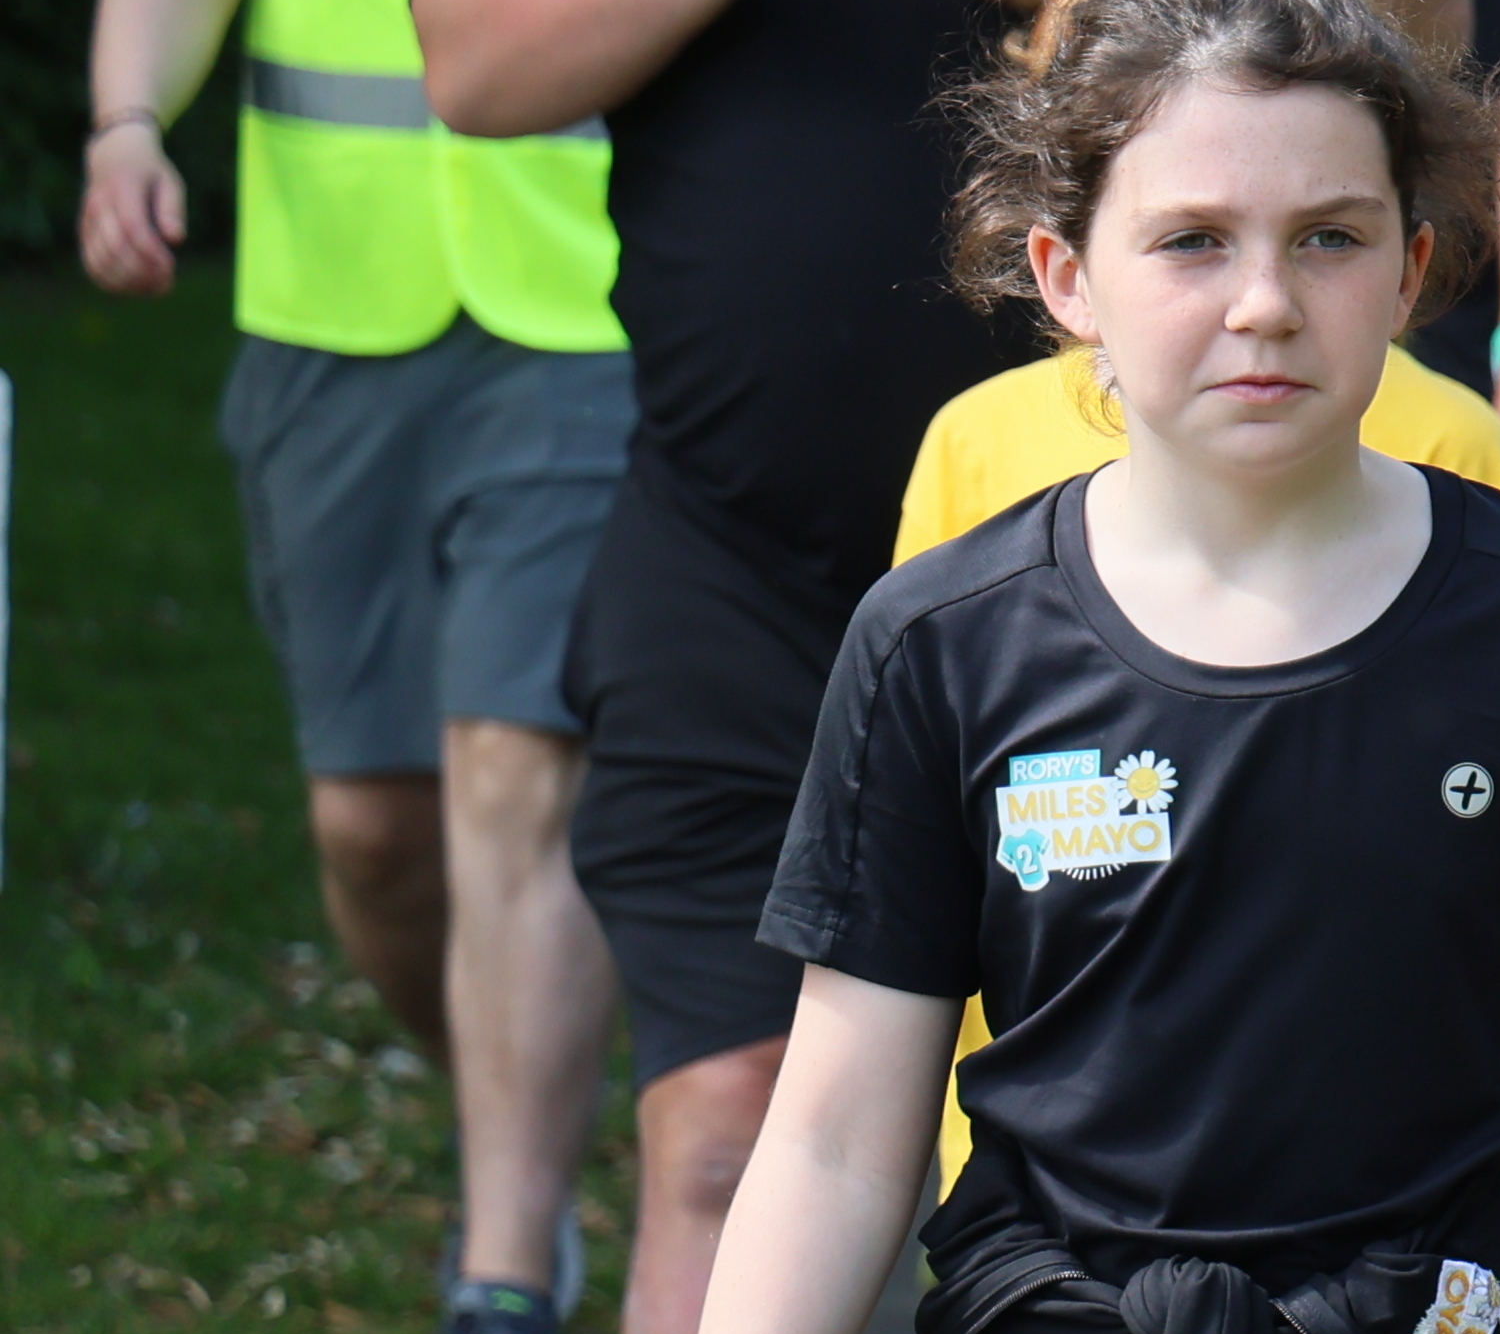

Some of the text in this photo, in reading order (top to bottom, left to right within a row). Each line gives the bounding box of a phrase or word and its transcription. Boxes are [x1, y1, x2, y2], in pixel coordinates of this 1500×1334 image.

[1013, 754, 1096, 782] RORY'S
[1006, 784, 1108, 825] MILES
[1016, 819, 1163, 875] 2 MAYO
